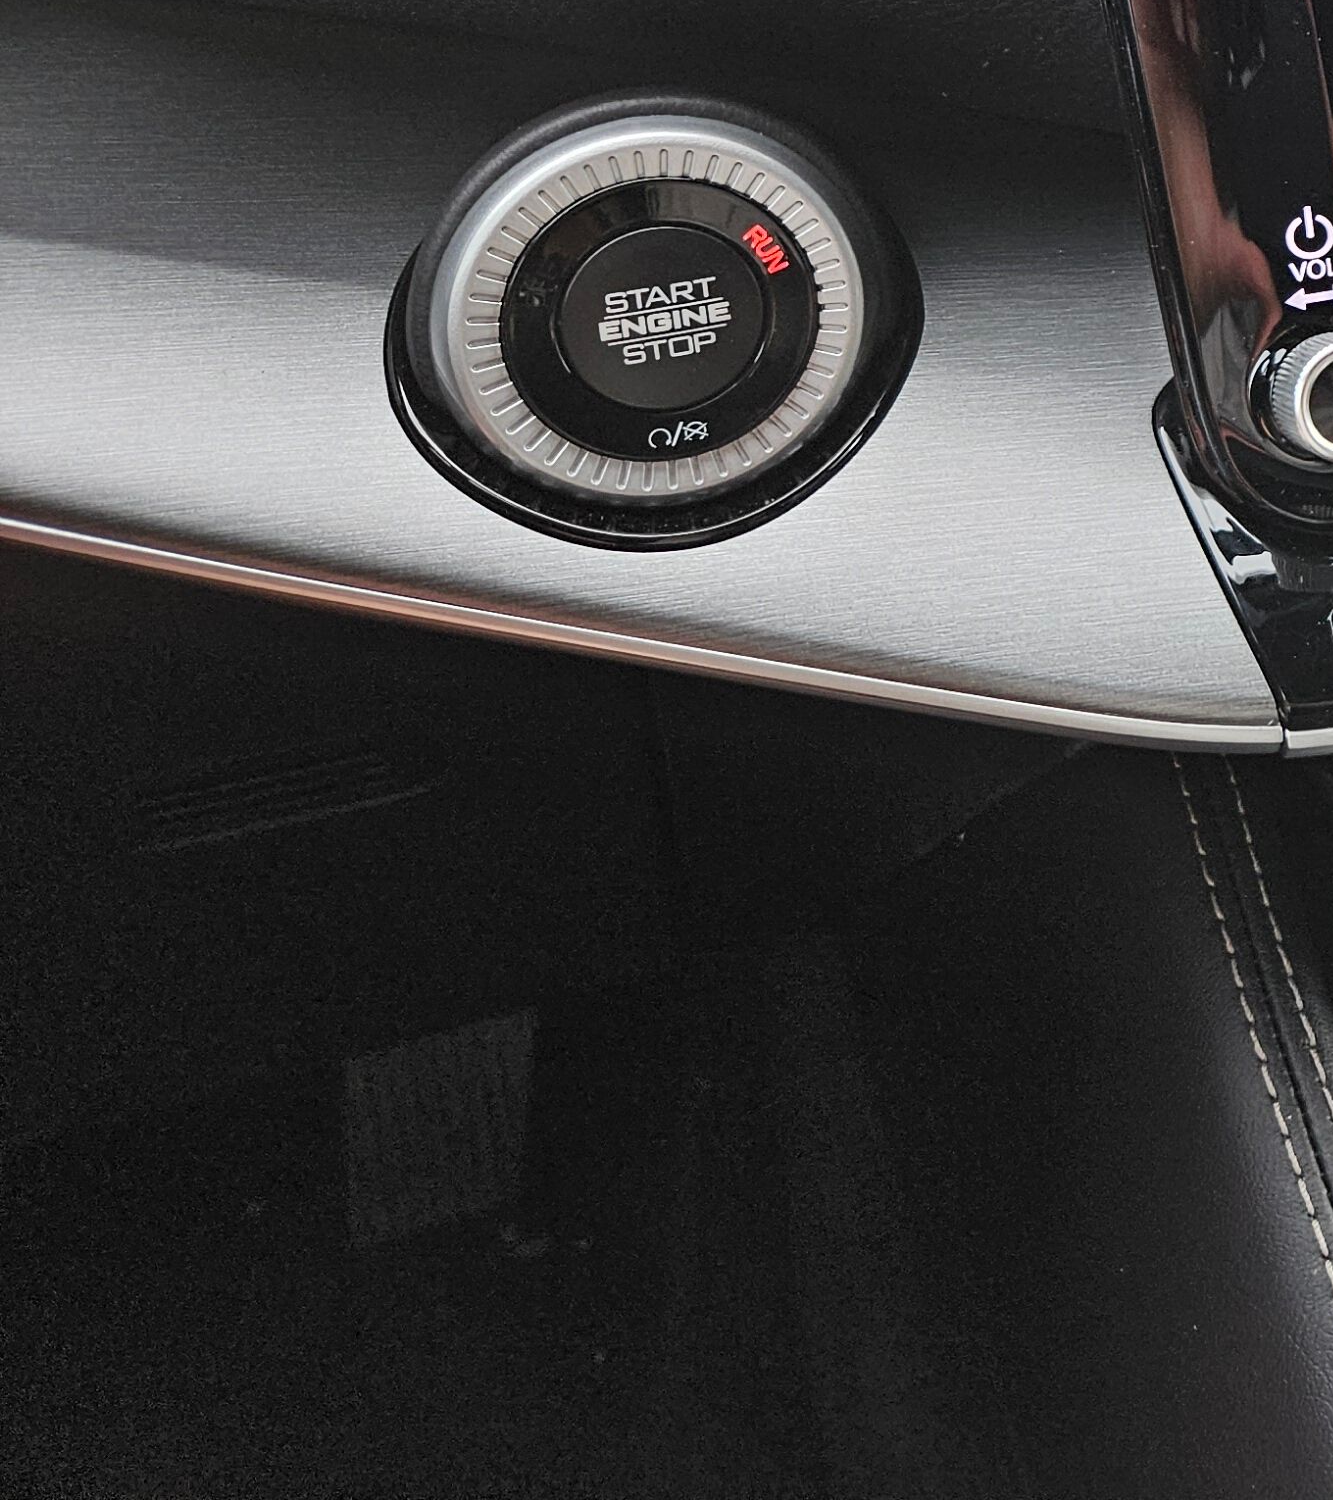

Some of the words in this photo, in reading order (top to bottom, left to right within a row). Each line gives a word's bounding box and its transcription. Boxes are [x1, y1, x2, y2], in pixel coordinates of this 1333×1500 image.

[742, 223, 788, 275] RUN
[604, 277, 717, 313] START
[598, 301, 731, 341] ENGINE
[623, 331, 716, 365] STOP
